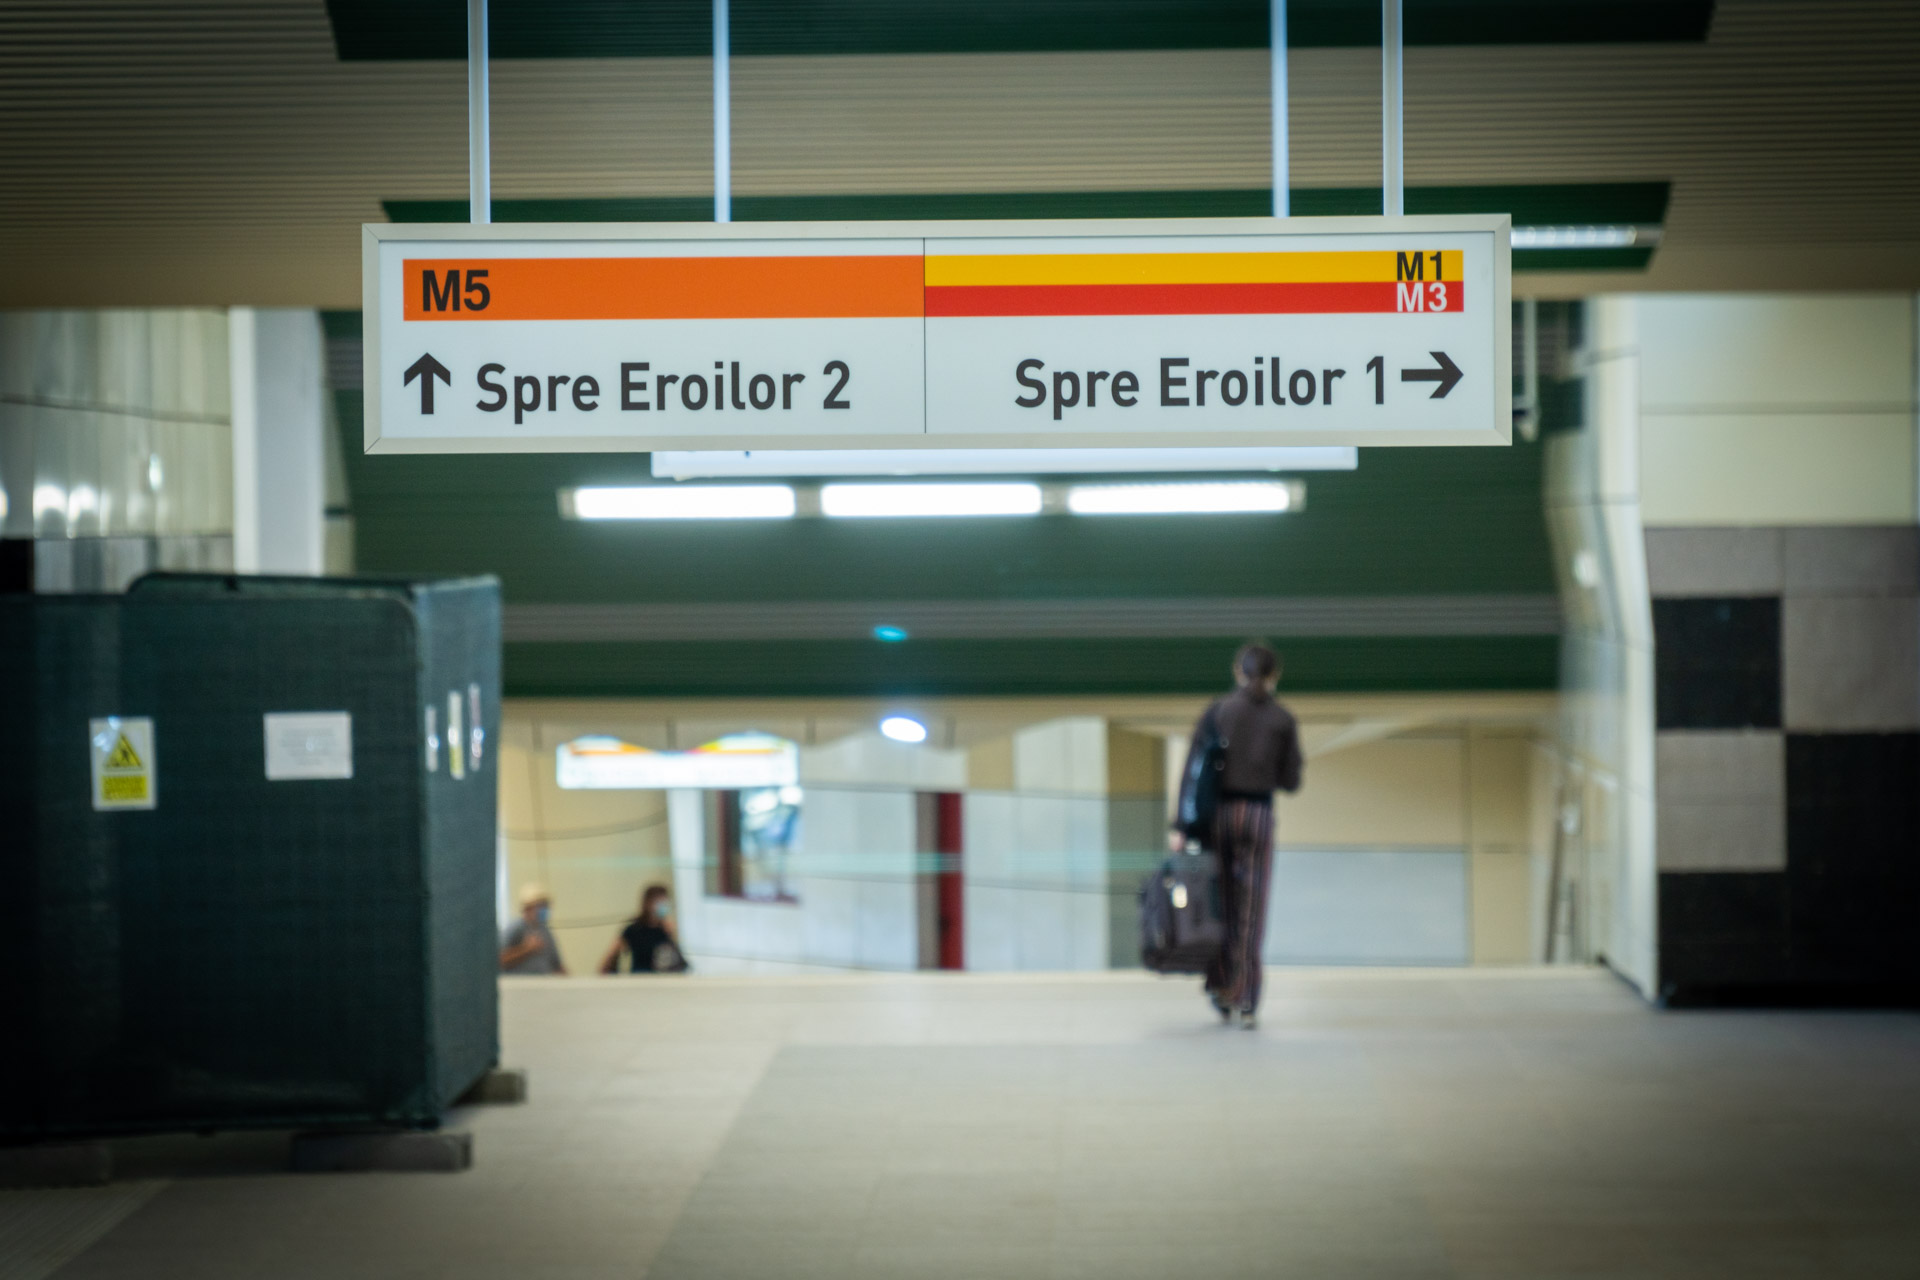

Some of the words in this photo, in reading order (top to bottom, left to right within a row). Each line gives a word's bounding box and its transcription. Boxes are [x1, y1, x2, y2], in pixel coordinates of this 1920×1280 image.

[1396, 251, 1442, 281] M1
[421, 268, 492, 313] M5
[1396, 283, 1448, 312] M3
[476, 362, 600, 425] Spre
[620, 360, 806, 412] Eroilor
[823, 360, 850, 410] 2
[1014, 358, 1140, 421] Spre
[1160, 356, 1346, 407] Eroilor
[1366, 356, 1384, 405] 1
